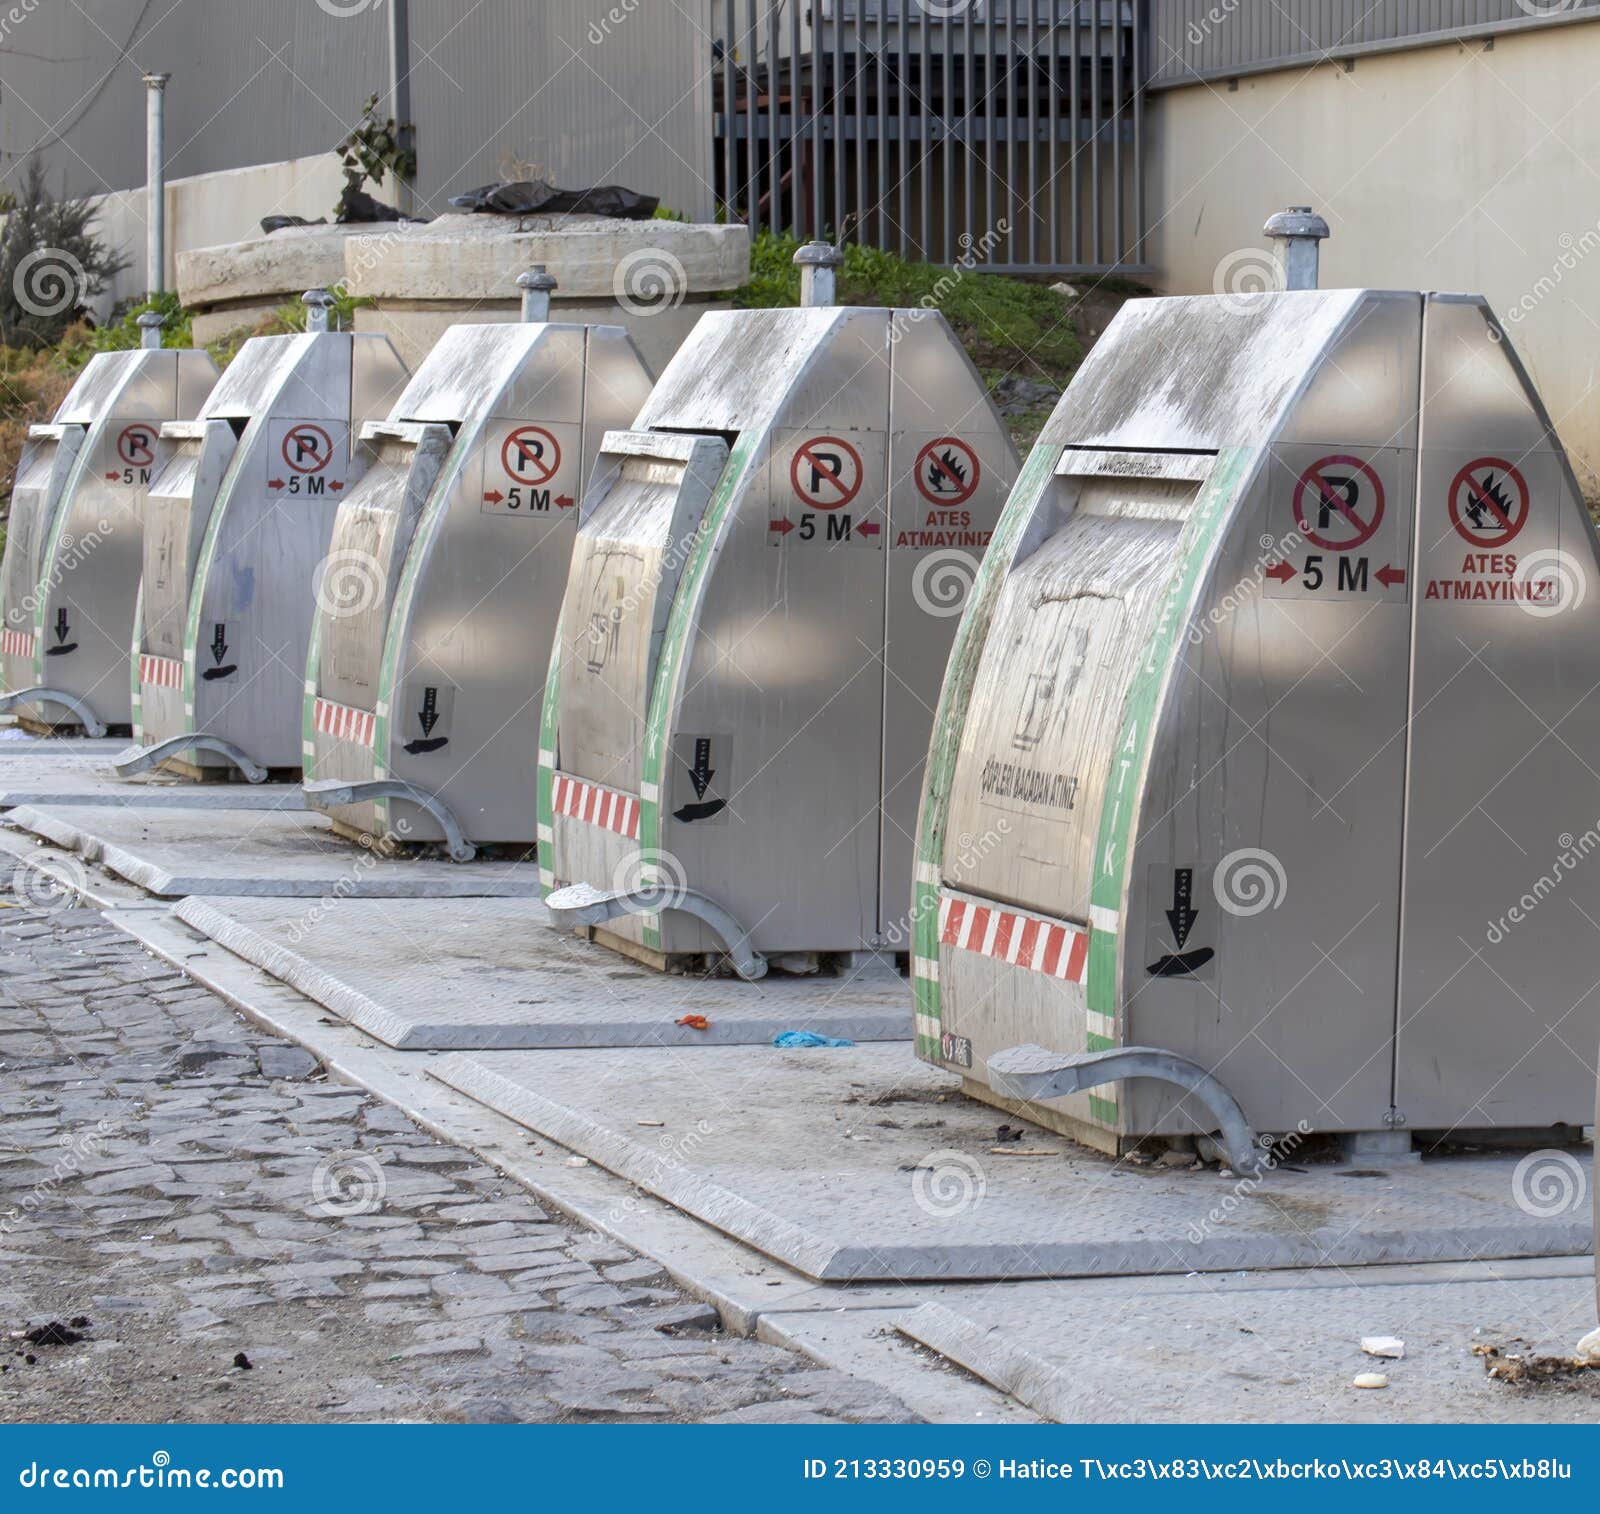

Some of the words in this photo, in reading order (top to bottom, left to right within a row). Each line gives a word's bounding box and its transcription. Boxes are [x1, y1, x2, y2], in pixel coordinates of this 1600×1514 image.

[124, 469, 133, 484] 5
[289, 476, 300, 493] 5
[308, 476, 325, 494] M
[508, 488, 521, 509] 5
[530, 489, 551, 511] M
[799, 514, 816, 540] 5
[827, 514, 852, 541] M
[926, 511, 971, 530] ATEŞ
[1303, 556, 1324, 591] 5
[1338, 556, 1369, 592] M
[1461, 553, 1517, 579] ATEŞ
[1424, 580, 1553, 601] ATMAYINIZ!
